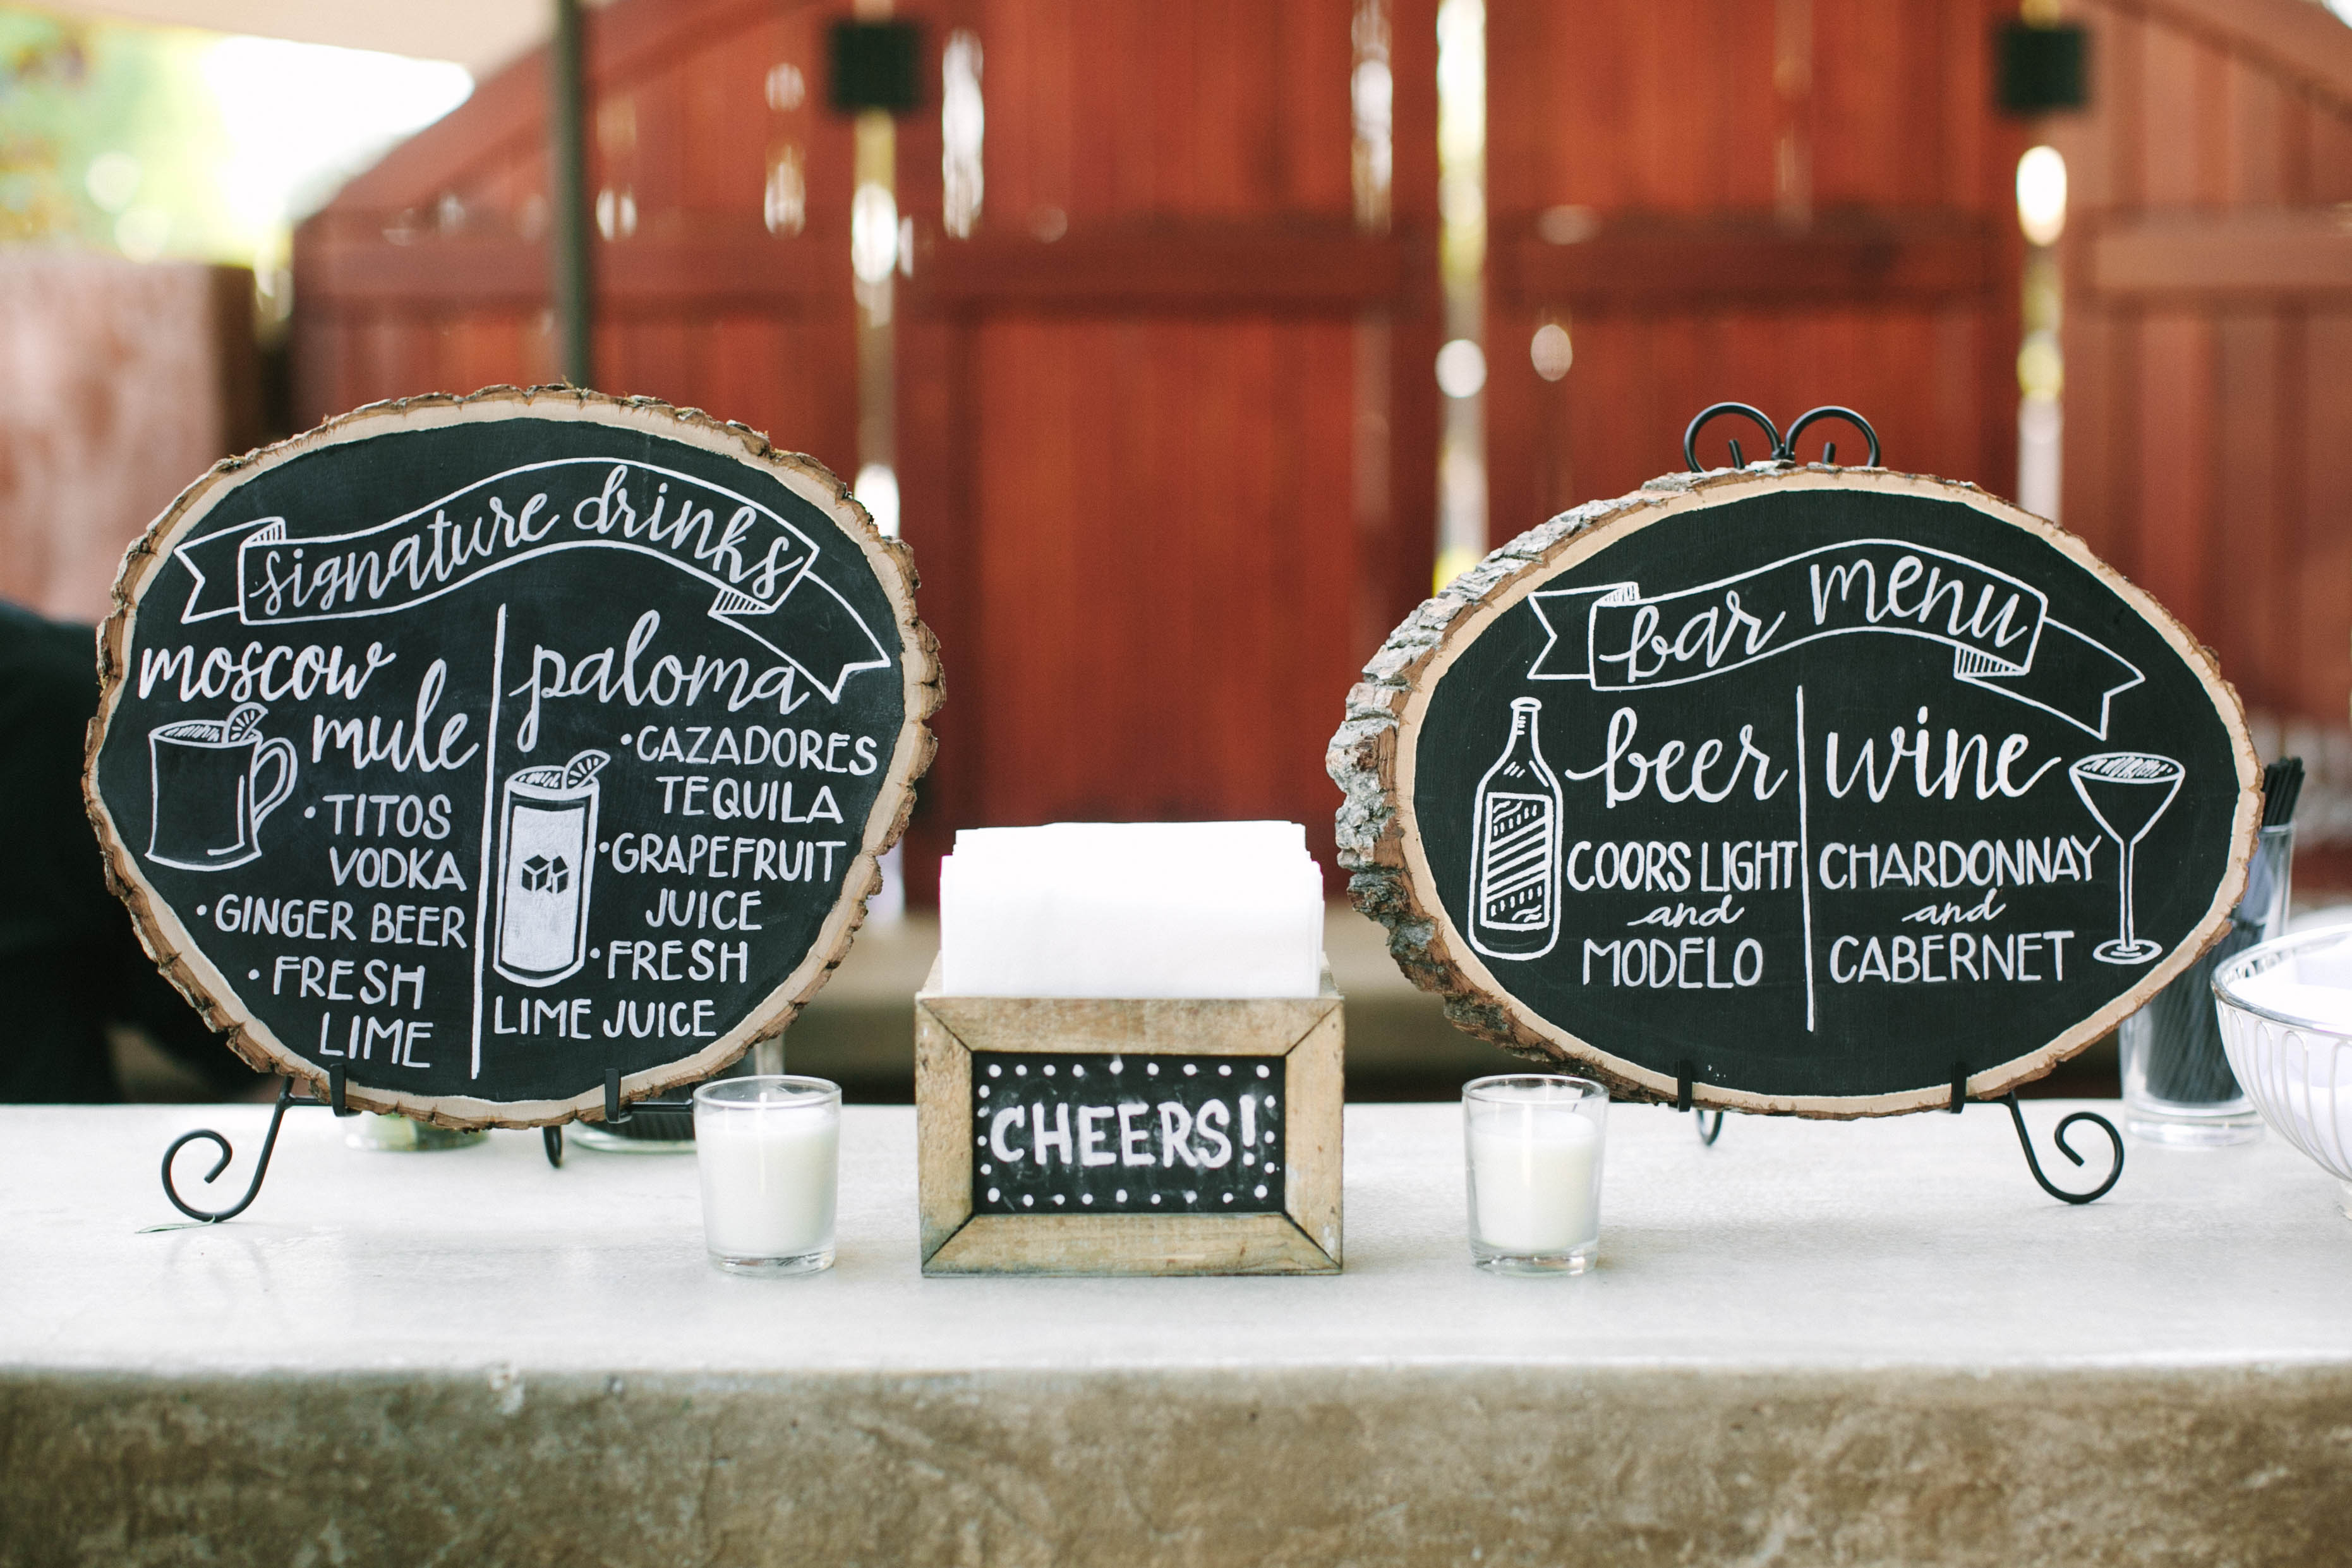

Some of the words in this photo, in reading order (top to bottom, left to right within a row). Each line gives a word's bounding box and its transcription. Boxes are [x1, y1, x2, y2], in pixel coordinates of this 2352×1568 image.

[249, 493, 560, 615] signature
[574, 464, 804, 600] drinks
[1599, 591, 1786, 683] bar
[1811, 555, 2027, 648] menu
[139, 641, 396, 702] moscow
[509, 610, 811, 752] paloma
[313, 658, 479, 772] mule
[637, 726, 877, 776] CAZADORES
[1565, 707, 1788, 809] beer
[1826, 706, 2061, 802] wine
[323, 794, 451, 839] TITOS
[656, 776, 843, 824] TEQUILA
[330, 847, 467, 891] VODKA
[612, 833, 847, 882] GRAPEFRUIT
[1567, 841, 1691, 892] COORS
[1701, 841, 1798, 892] LIGHT
[1819, 835, 2101, 890] CHARDONNAY
[215, 894, 356, 940] GINGER
[371, 903, 467, 948] BEER
[646, 888, 762, 930] JUICE
[1627, 895, 1744, 927] and
[1902, 888, 2006, 926] and
[274, 956, 425, 1010] FRESH
[608, 939, 747, 983] FRESH
[1583, 937, 1763, 989] MODELO
[1830, 931, 2074, 983] CABERNET
[320, 1012, 433, 1068] LIME
[495, 996, 591, 1039] LIME
[603, 1000, 716, 1037] JUICE
[991, 1094, 1257, 1168] CHEERS!
